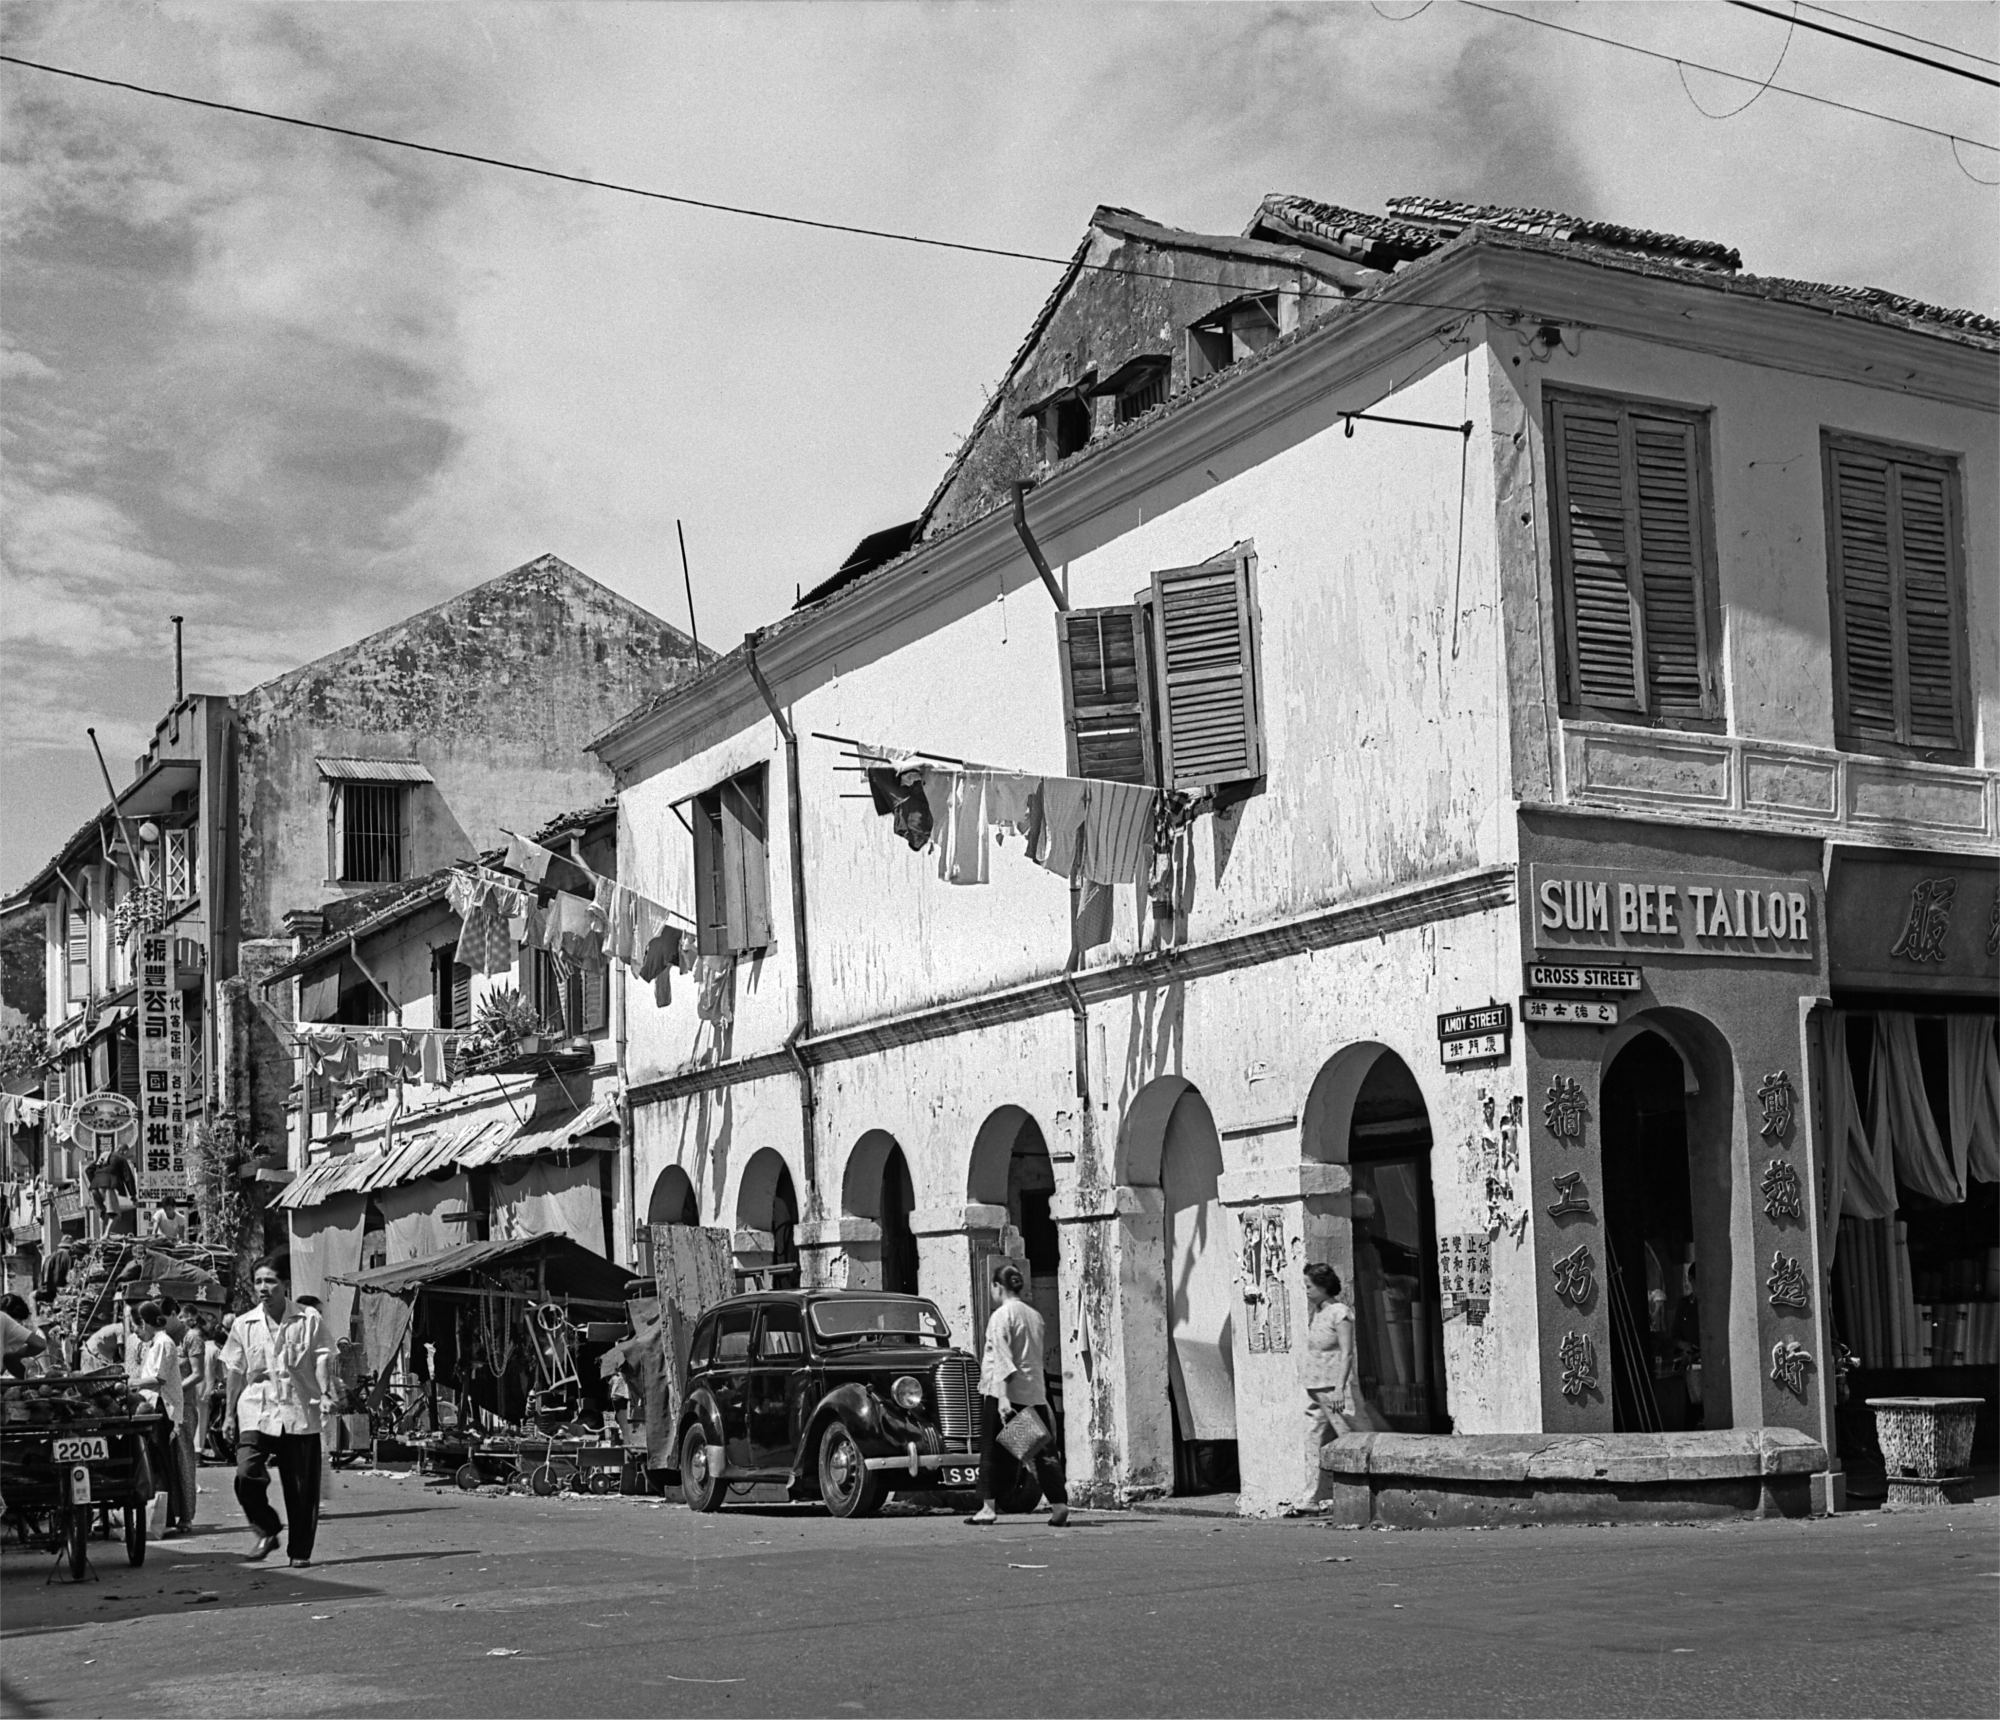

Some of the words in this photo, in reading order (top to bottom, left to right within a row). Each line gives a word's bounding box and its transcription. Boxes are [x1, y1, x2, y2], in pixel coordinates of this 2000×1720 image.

[1540, 880, 1609, 932] SUM
[1618, 882, 1678, 934] BEE
[1687, 886, 1809, 941] TAILOR
[144, 938, 167, 1038] 振豐公司
[1534, 968, 1579, 985] CROSS
[1584, 969, 1634, 987] STREET
[1444, 1015, 1467, 1033] AMOY
[1469, 1009, 1503, 1029] STREET
[58, 1441, 105, 1460] 2204
[950, 1467, 962, 1482] S
